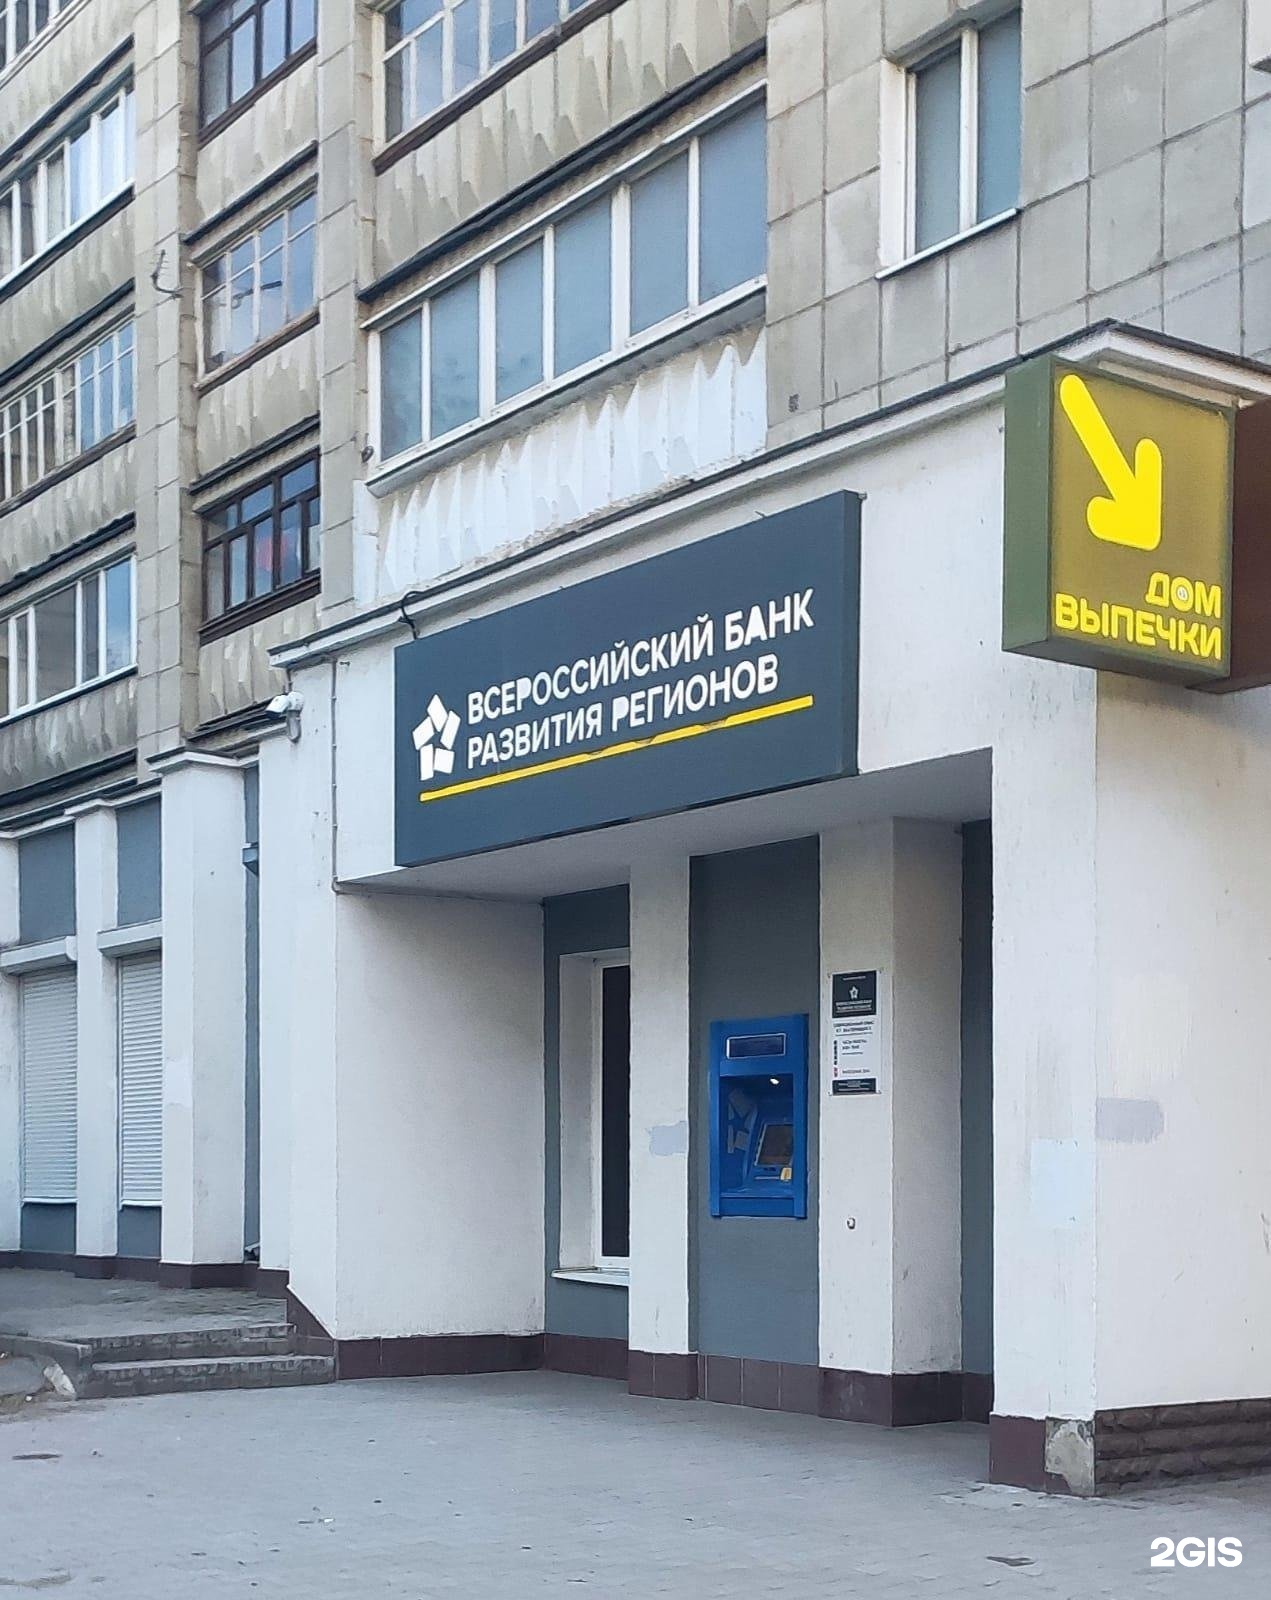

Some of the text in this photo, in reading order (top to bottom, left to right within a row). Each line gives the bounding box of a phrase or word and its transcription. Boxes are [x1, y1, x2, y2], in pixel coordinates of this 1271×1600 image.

[1055, 593, 1222, 660] ВЫПЕЧКИ
[1145, 571, 1222, 619] ДОМ
[467, 588, 814, 725] ВСЕРОССИЙСКИЙ БАНК
[467, 653, 779, 769] РАЗВИТИЯ РЕГИОНОВ
